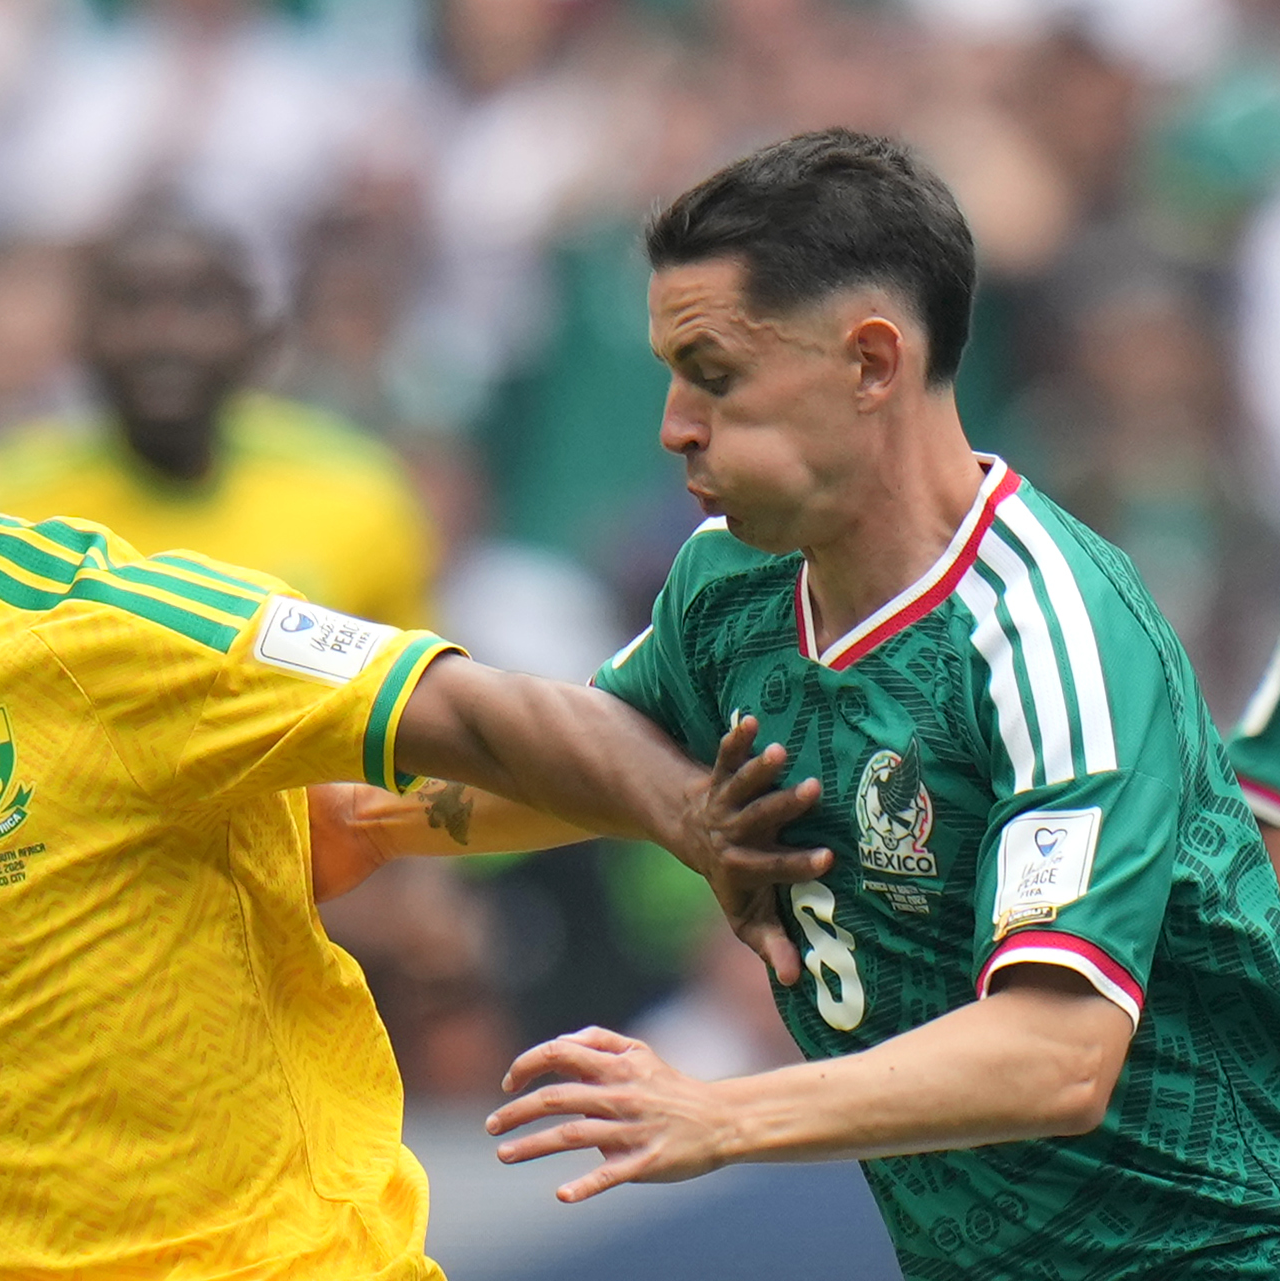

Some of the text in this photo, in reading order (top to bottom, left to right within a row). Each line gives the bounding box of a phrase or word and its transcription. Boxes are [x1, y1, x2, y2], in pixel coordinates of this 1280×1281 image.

[330, 620, 360, 654] PEAC
[860, 846, 933, 873] MÉXICO
[790, 881, 865, 1031] 8
